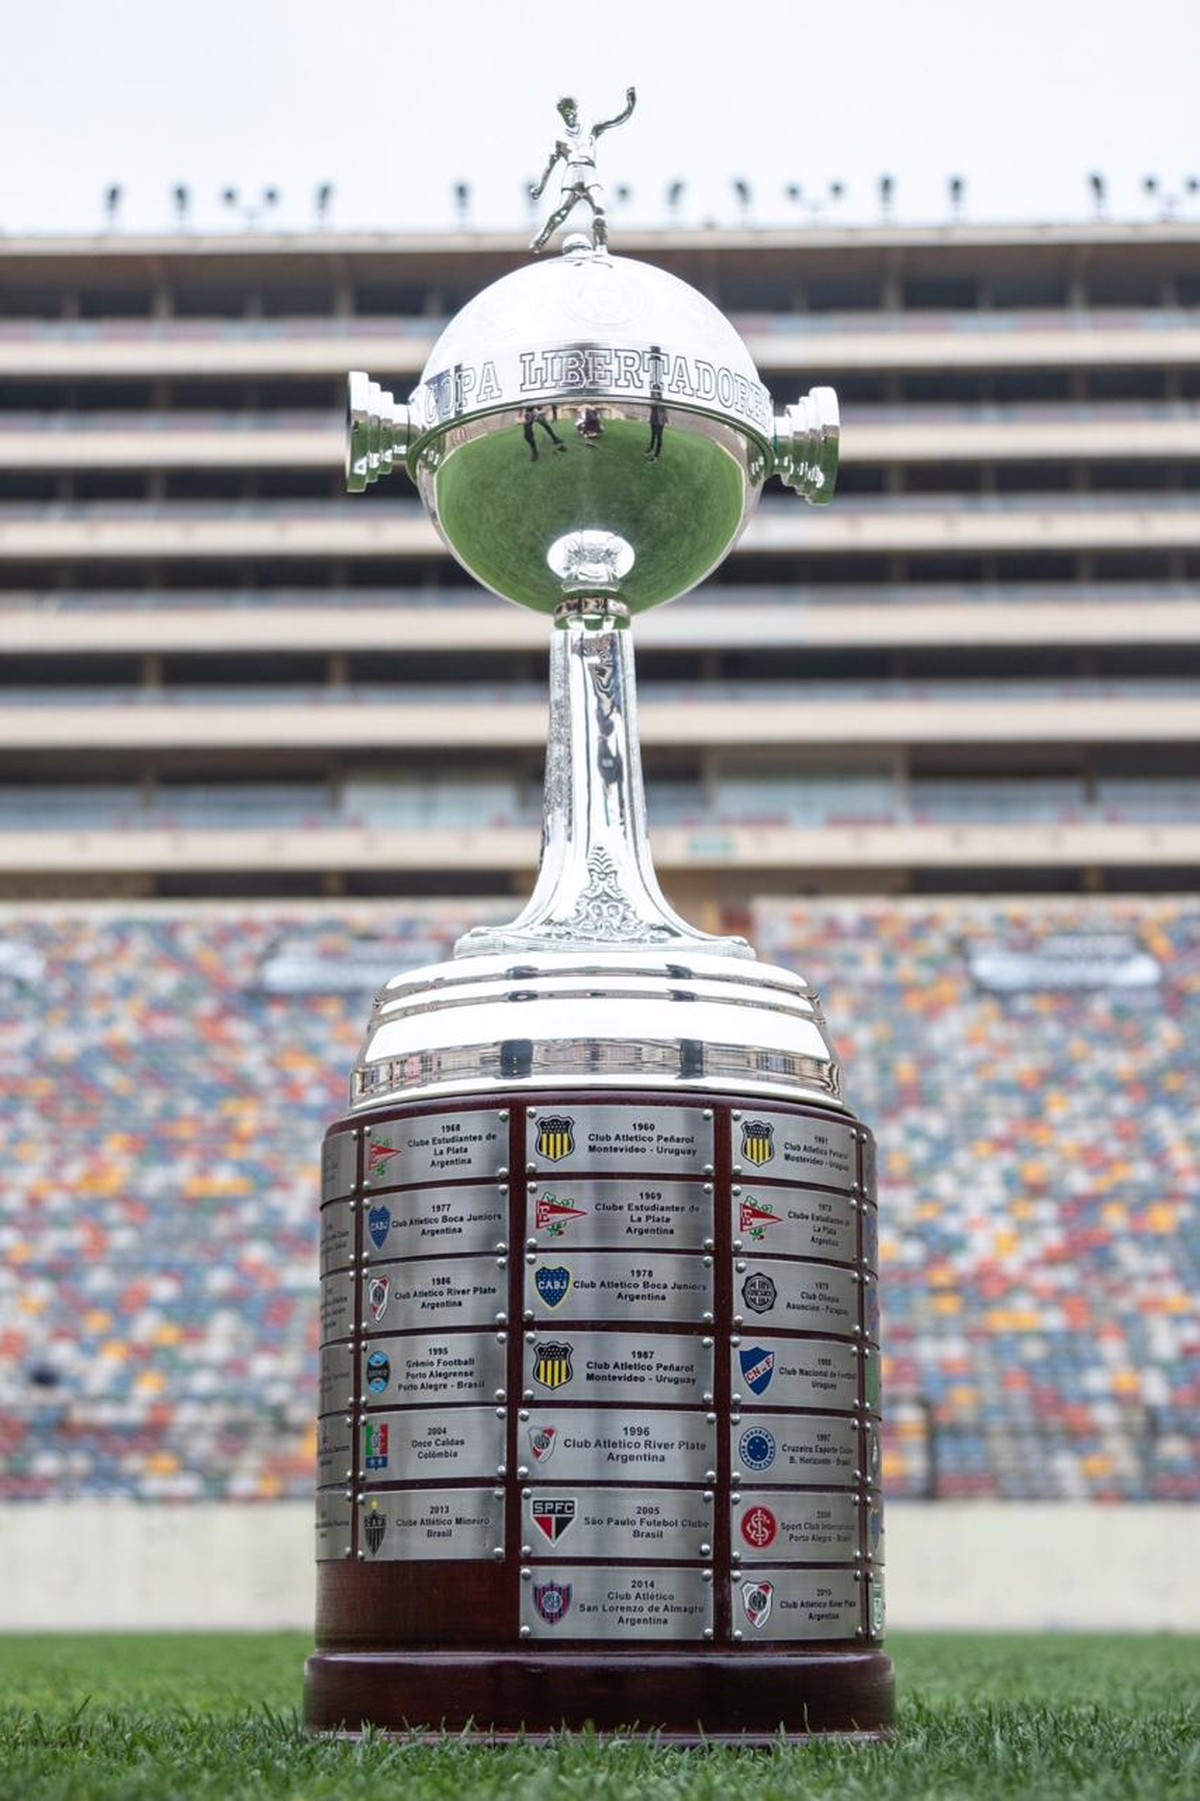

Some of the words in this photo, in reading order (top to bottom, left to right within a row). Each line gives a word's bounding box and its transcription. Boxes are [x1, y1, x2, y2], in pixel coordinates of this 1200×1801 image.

[424, 361, 502, 424] COPA
[632, 1123, 655, 1131] 1960
[408, 1138, 429, 1148] Clube
[486, 1133, 497, 1141] de
[614, 1134, 653, 1142] Atletico
[657, 1135, 694, 1143] Peñarol
[434, 1147, 444, 1155] La
[784, 1142, 800, 1151] Club
[657, 1147, 697, 1157] Uruguay
[431, 1157, 472, 1168] Argentina
[431, 1204, 451, 1212] 1977
[595, 1203, 623, 1212] Clube
[627, 1204, 685, 1212] Estudiantes
[630, 1215, 642, 1223] La
[646, 1215, 670, 1223] Plata
[788, 1211, 809, 1220] Clube
[392, 1220, 407, 1228] Club
[409, 1217, 439, 1226] Atletico
[442, 1215, 464, 1223] Boca
[467, 1213, 502, 1221] Juniors
[421, 1227, 462, 1237] Argentina
[626, 1226, 674, 1236] Argentina
[630, 1270, 653, 1278] 1978
[538, 1281, 567, 1289] CABJ
[573, 1281, 596, 1289] Club
[600, 1281, 639, 1289] Atletico
[643, 1282, 667, 1290] Boca
[671, 1282, 707, 1290] Juniors
[395, 1292, 410, 1300] Club
[413, 1289, 444, 1298] Atletico
[447, 1287, 471, 1296] River
[473, 1286, 496, 1294] Plate
[617, 1293, 666, 1301] Argentina
[800, 1291, 816, 1300] Club
[421, 1300, 462, 1310] Argentina
[437, 1358, 474, 1366] Football
[613, 1362, 652, 1371] Atletico
[656, 1363, 694, 1372] Peñarol
[779, 1367, 797, 1375] Club
[405, 1371, 426, 1379] Porto
[429, 1371, 474, 1380] Alegrense
[586, 1374, 645, 1382] Montevideo
[656, 1375, 696, 1385] Uruguay
[420, 1383, 447, 1393] Alegre
[457, 1380, 485, 1389] Brasil
[427, 1427, 447, 1435] 2004
[623, 1427, 650, 1436] 1996
[435, 1438, 465, 1446] Caldas
[564, 1439, 591, 1448] Club
[595, 1440, 641, 1449] Atletico
[644, 1440, 675, 1450] River
[678, 1442, 706, 1451] Plate
[607, 1453, 665, 1463] Argentina
[430, 1506, 449, 1514] 2013
[534, 1501, 574, 1513] SPFC
[636, 1506, 660, 1515] 2005
[455, 1517, 490, 1525] Mineiro
[584, 1517, 603, 1525] São
[607, 1518, 636, 1526] Paulo
[639, 1518, 678, 1527] Futebol
[682, 1520, 709, 1528] Clube
[427, 1529, 452, 1538] Brasil
[632, 1530, 663, 1538] Brasil
[631, 1580, 655, 1588] 2014
[608, 1592, 631, 1600] Club
[635, 1591, 674, 1600] Atlético
[579, 1604, 599, 1612] San
[602, 1605, 644, 1613] Lorenzo
[664, 1604, 704, 1615] Almagro
[617, 1616, 668, 1626] Argentina
